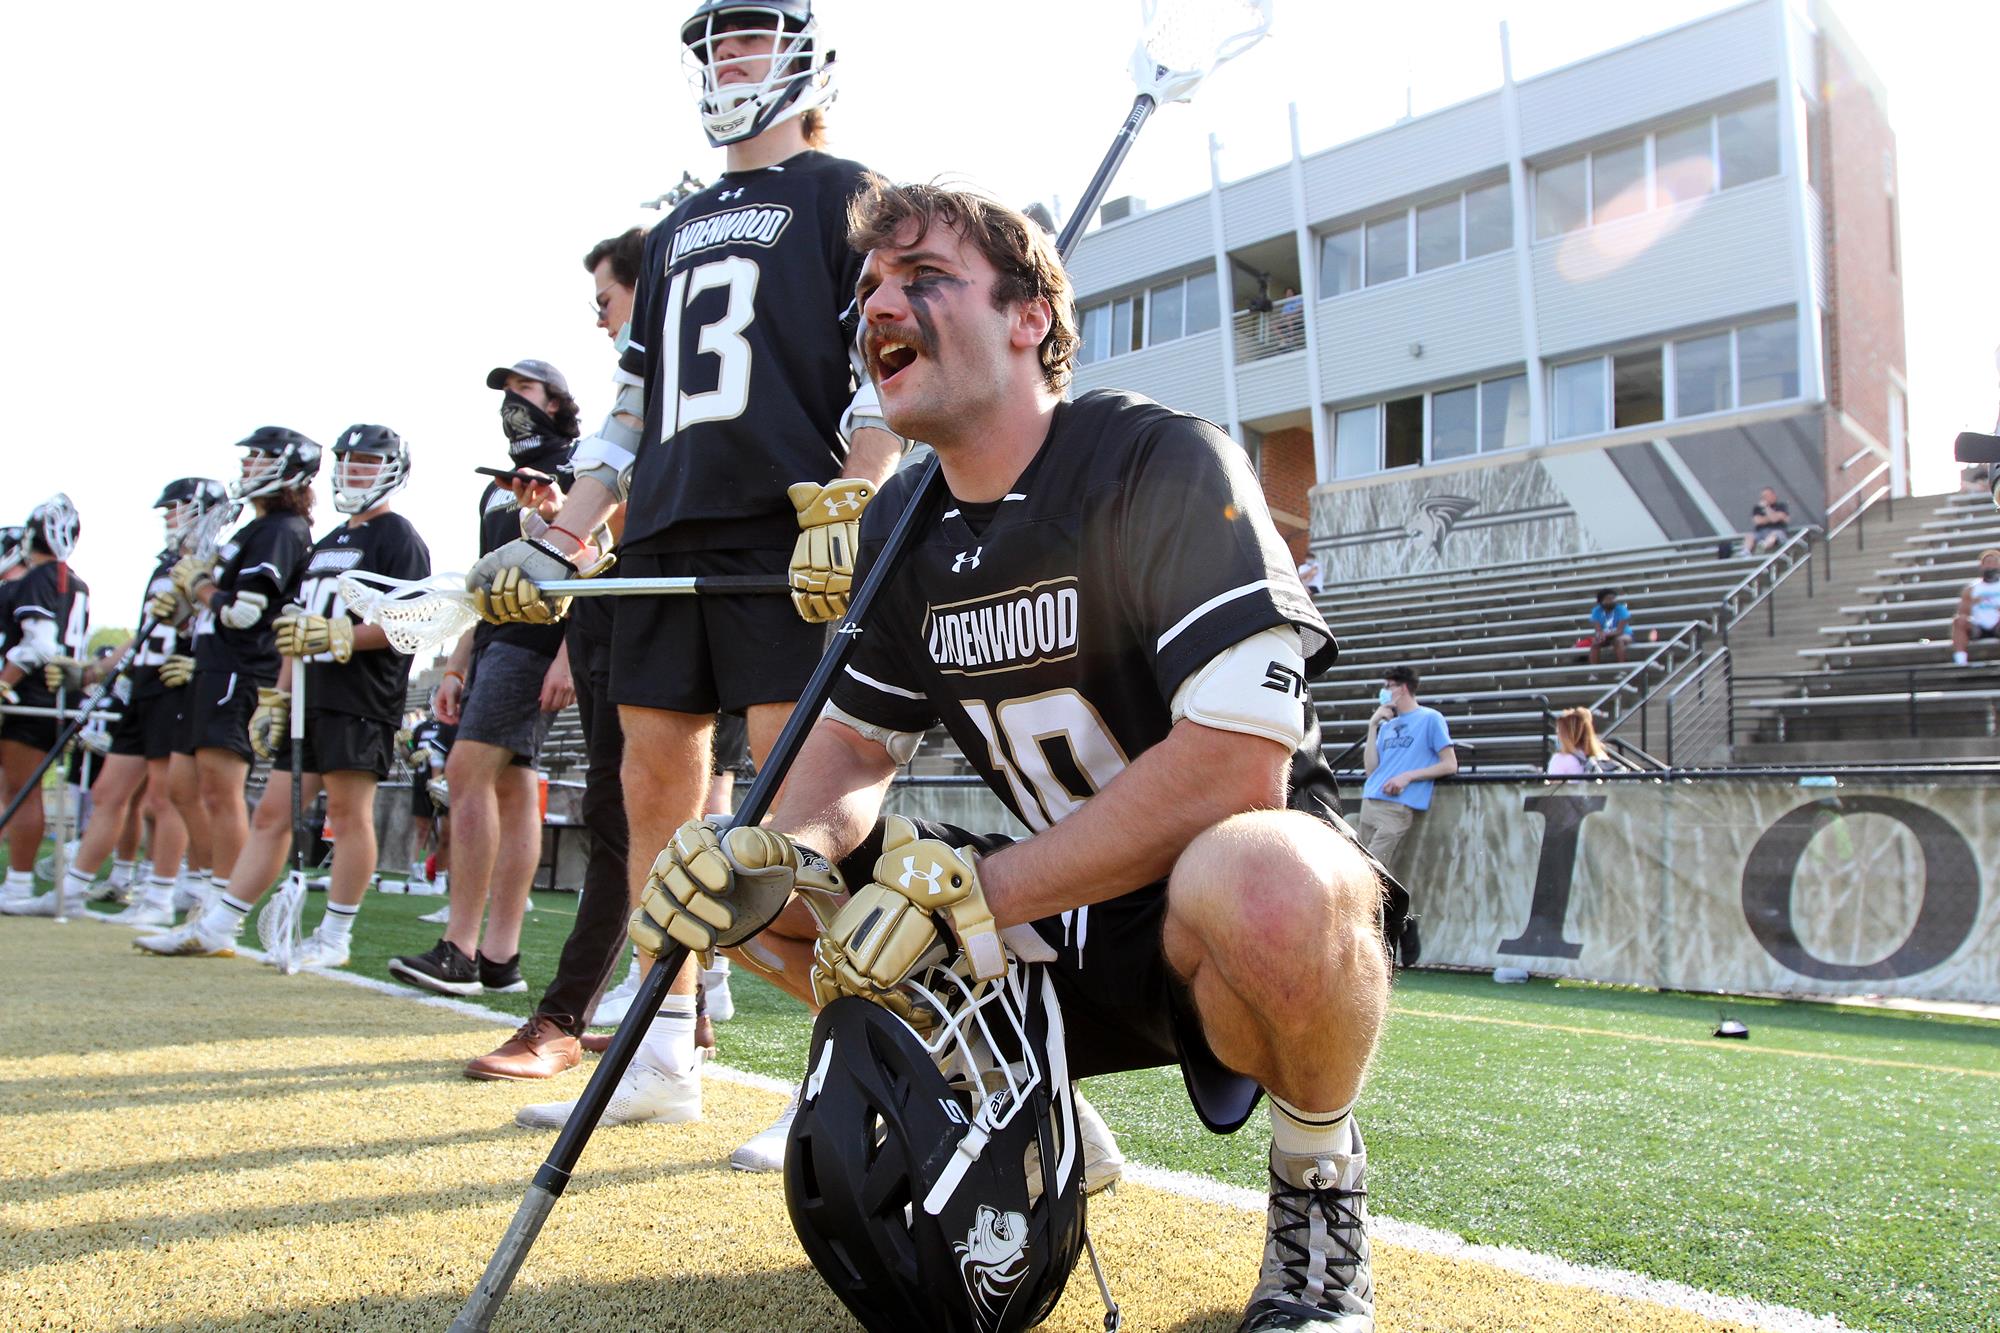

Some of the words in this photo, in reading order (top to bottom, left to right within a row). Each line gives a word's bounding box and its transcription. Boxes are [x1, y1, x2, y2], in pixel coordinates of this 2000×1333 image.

[669, 208, 786, 267] LNDENWOOD
[660, 255, 760, 444] 13
[1261, 661, 1309, 699] ST
[960, 687, 1130, 834] 10
